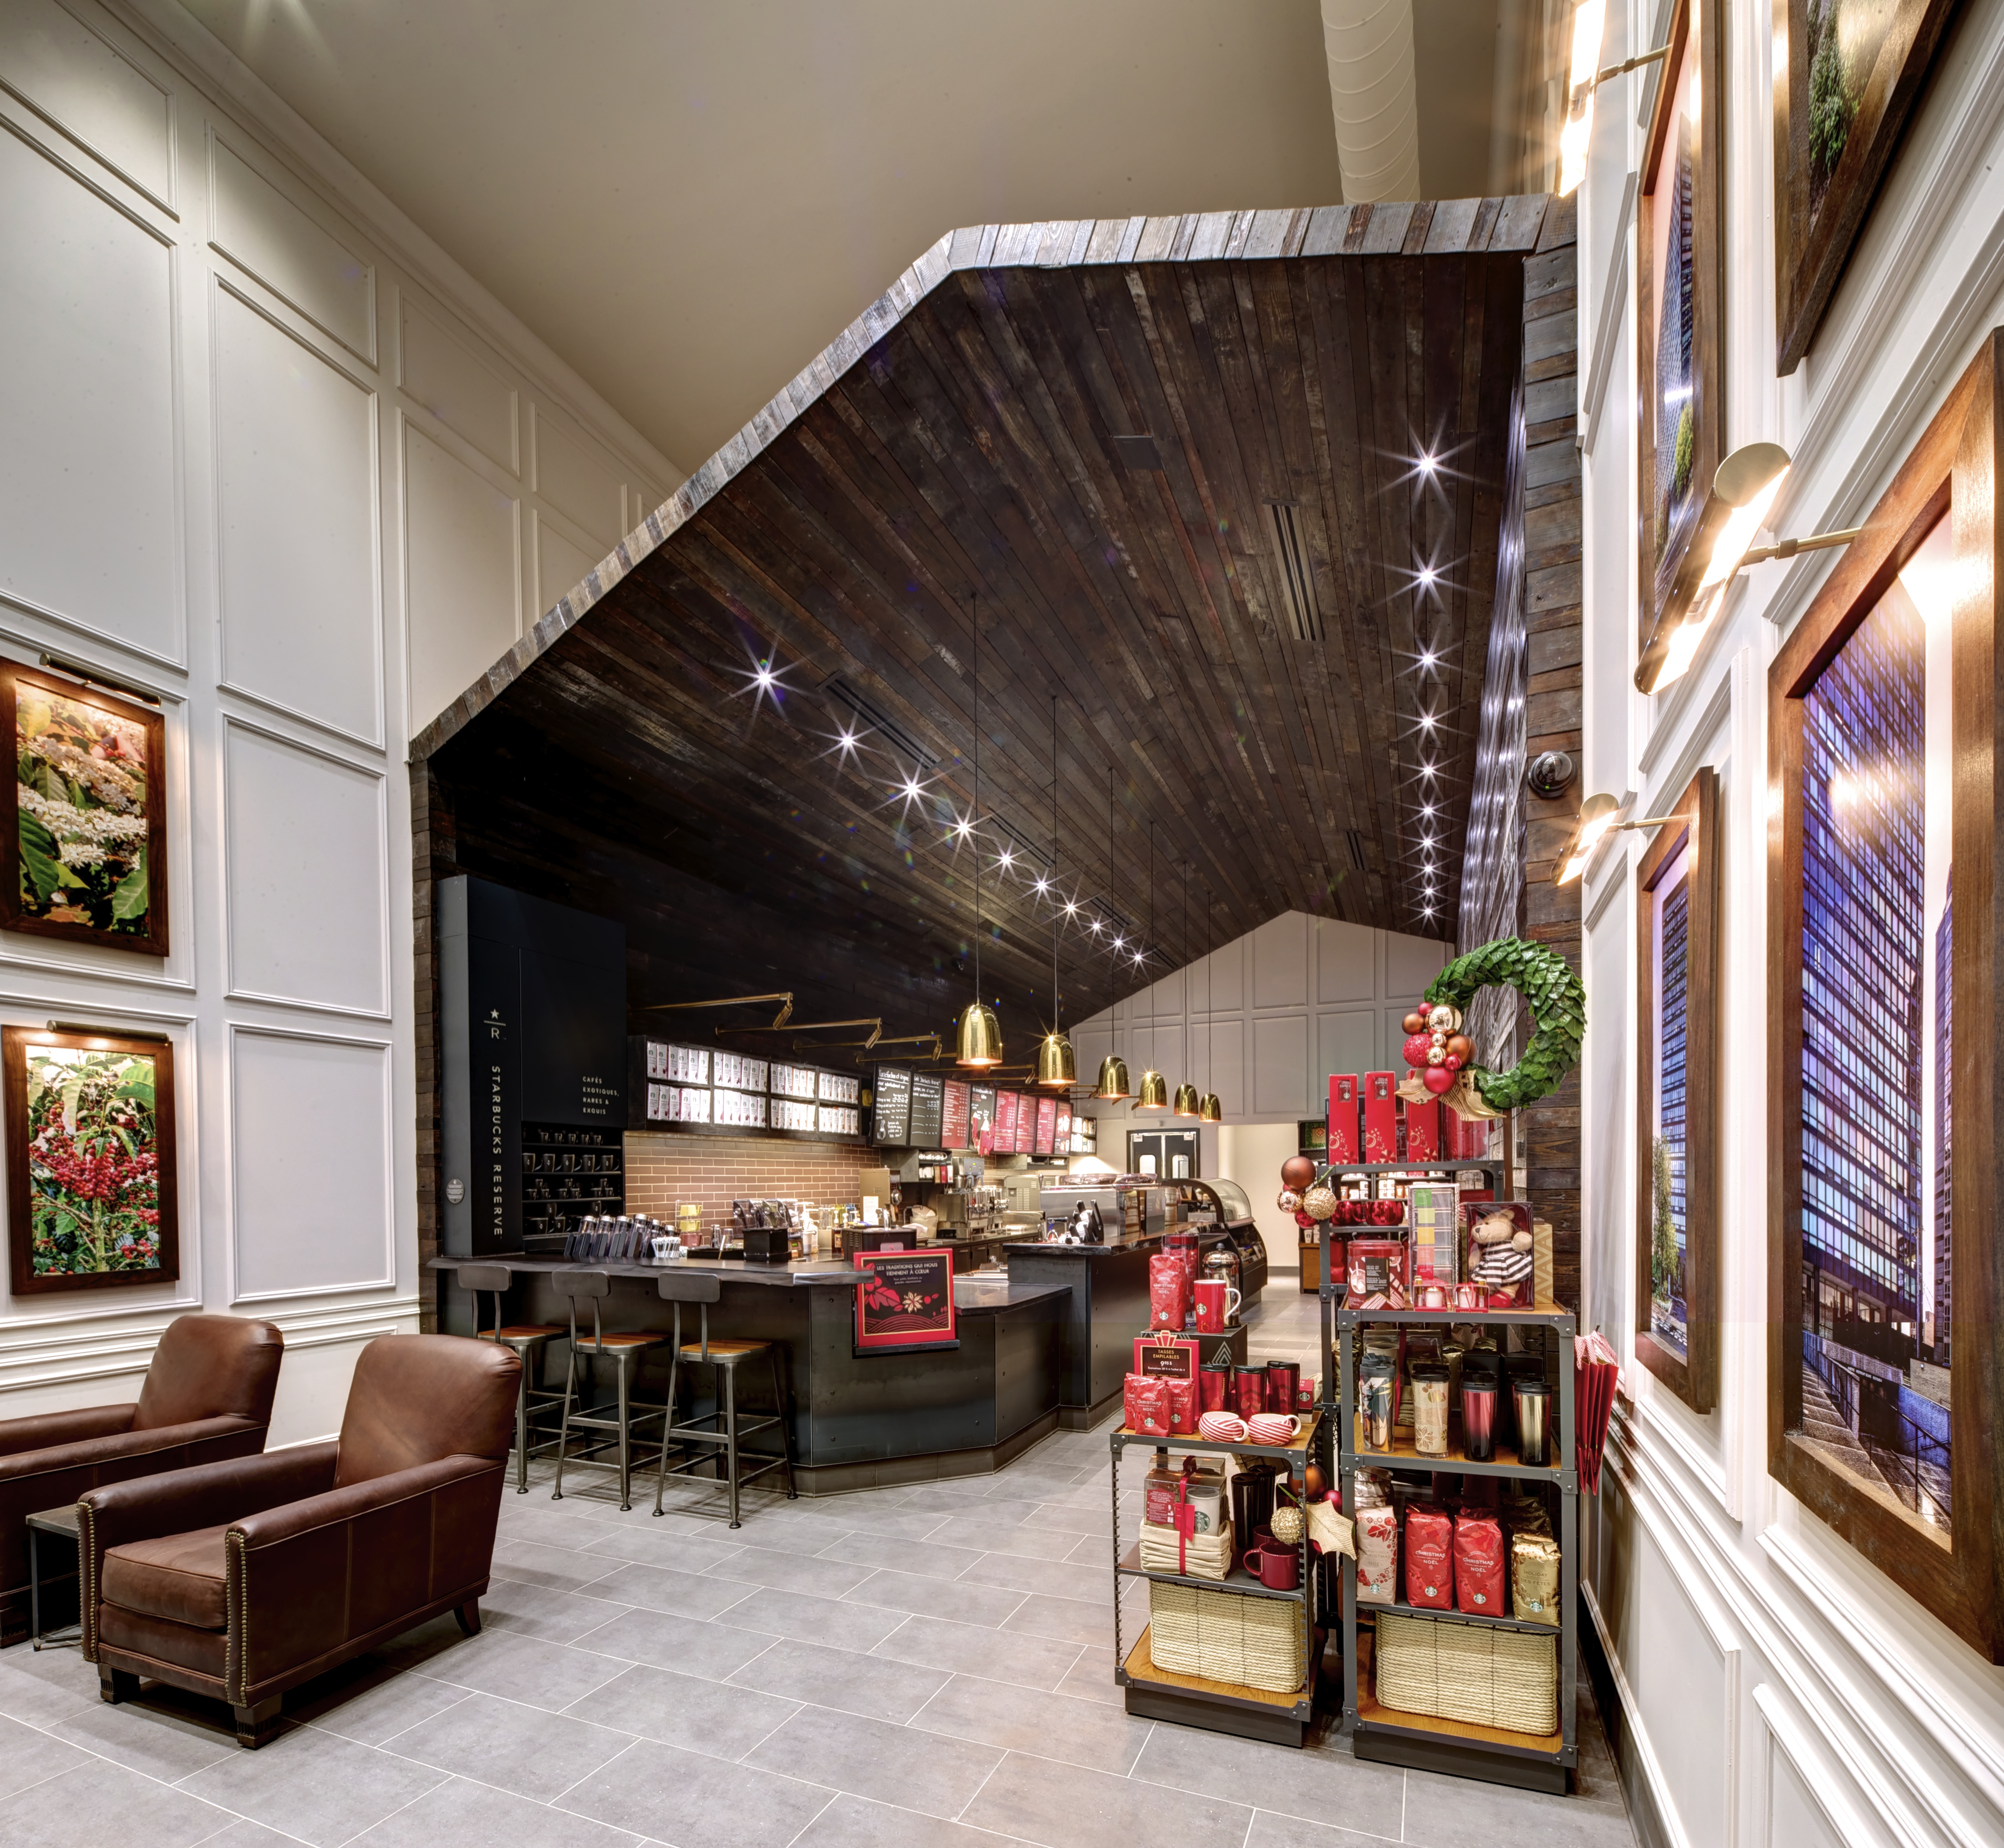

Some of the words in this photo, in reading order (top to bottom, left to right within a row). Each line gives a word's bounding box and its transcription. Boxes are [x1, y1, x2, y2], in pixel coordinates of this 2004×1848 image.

[491, 1027, 499, 1039] R
[583, 1076, 602, 1084] CAFÉS
[583, 1086, 619, 1097] EXOTIQUES,
[492, 1065, 501, 1155] STARBUCKS
[493, 1165, 503, 1236] RESERVE
[1415, 1550, 1446, 1558] CHRISTMAS
[1463, 1557, 1494, 1566] CHRISTMAS
